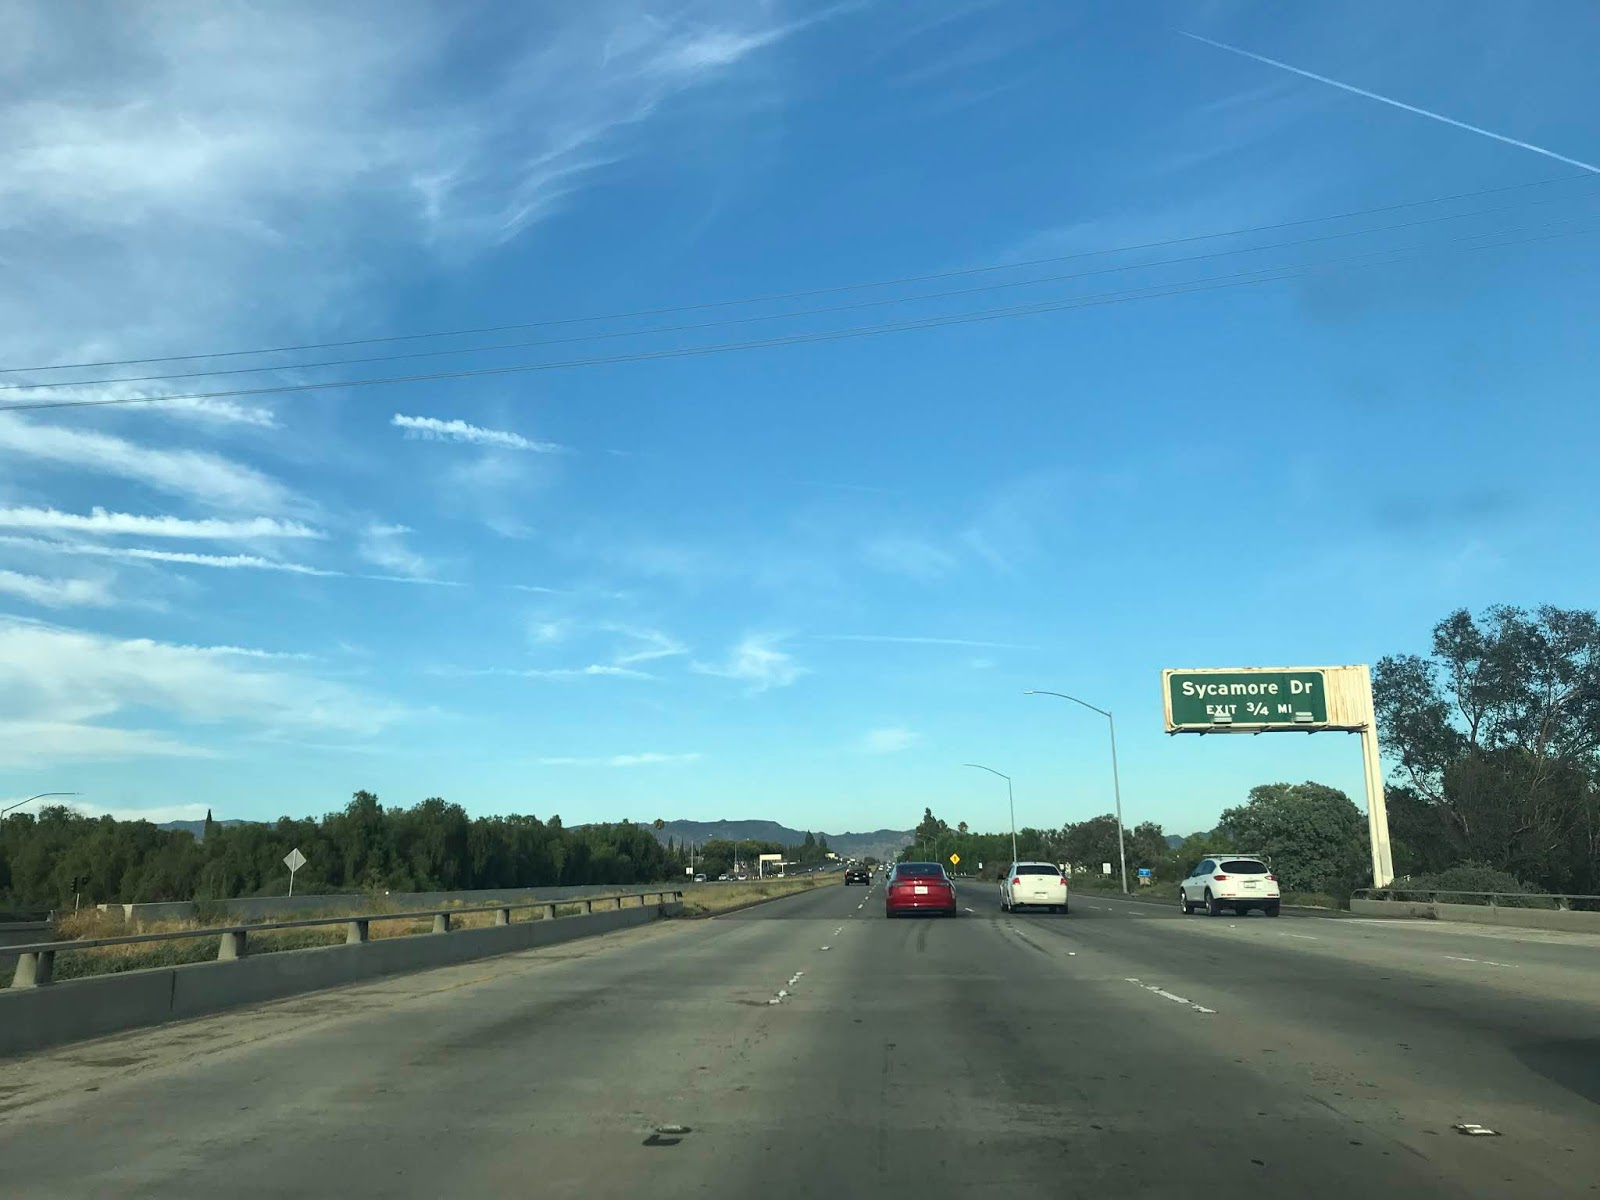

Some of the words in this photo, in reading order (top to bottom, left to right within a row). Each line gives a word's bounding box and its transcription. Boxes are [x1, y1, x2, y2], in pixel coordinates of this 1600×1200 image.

[1182, 680, 1279, 699] Sycamore
[1290, 679, 1313, 694] Dr
[1206, 704, 1237, 715] EXIT
[1246, 702, 1269, 716] 3/4
[1277, 704, 1292, 714] MI
